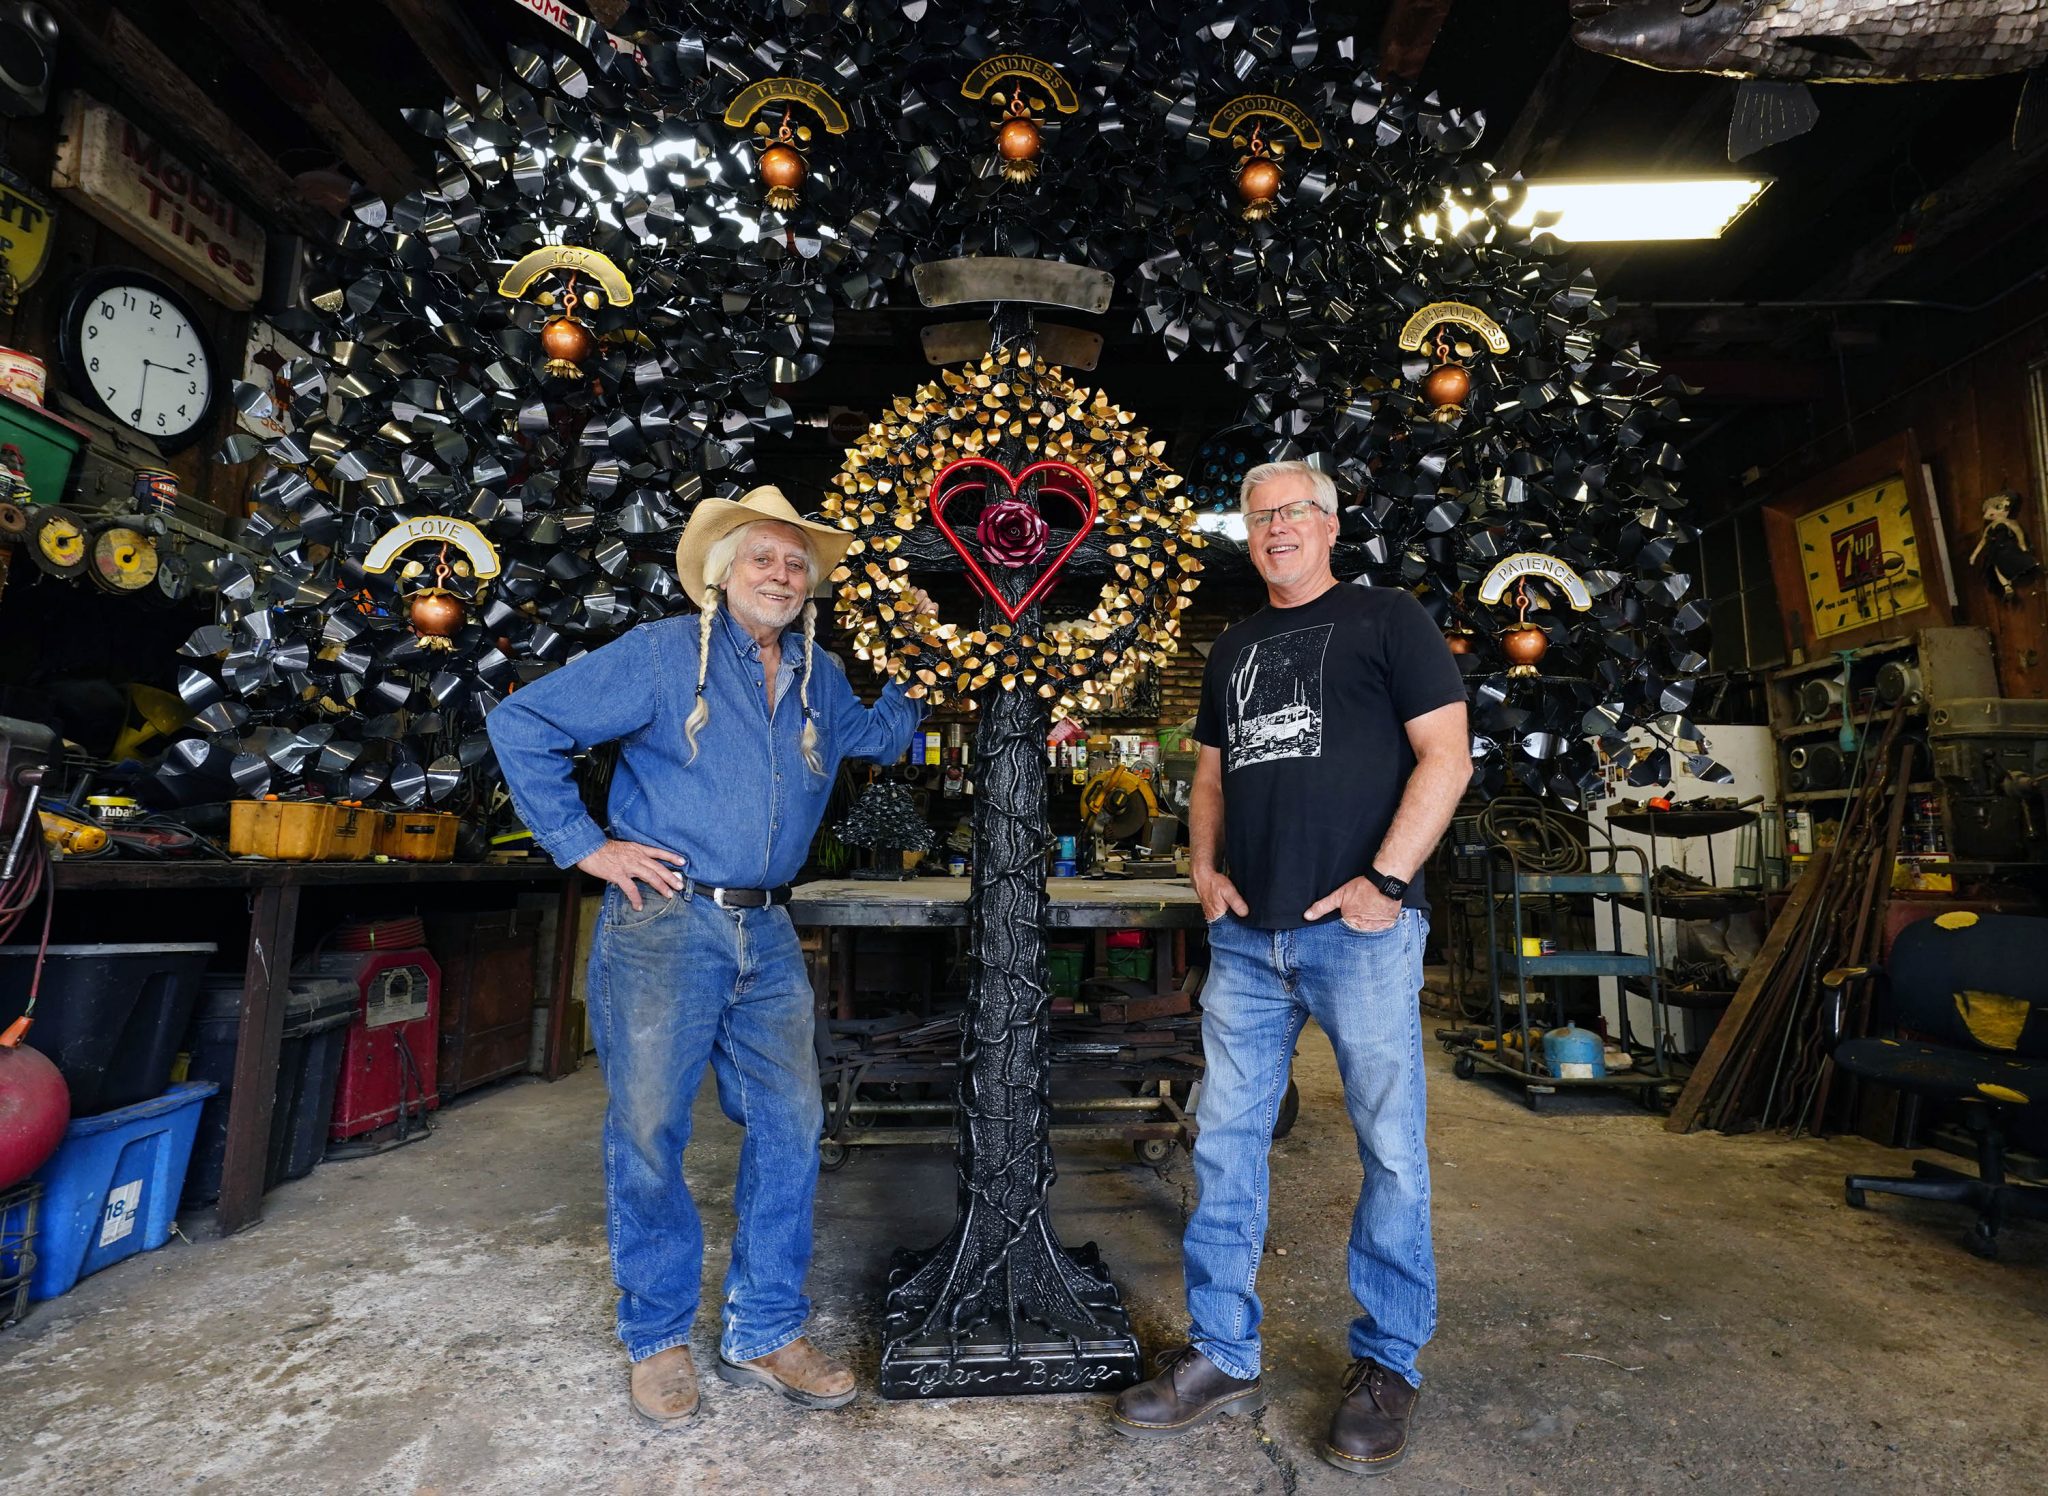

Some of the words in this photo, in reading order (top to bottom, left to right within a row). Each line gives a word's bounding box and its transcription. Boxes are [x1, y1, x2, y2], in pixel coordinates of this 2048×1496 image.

[980, 58, 1063, 88] KINDNESS
[756, 81, 819, 101] PEACE
[1223, 98, 1309, 130] GOODNESS
[121, 121, 239, 238] Mobil
[138, 175, 255, 286] Tires
[551, 251, 589, 265] JOY
[101, 301, 115, 320] 10
[122, 292, 136, 312] 11
[150, 301, 163, 319] 12
[88, 325, 98, 339] 9
[176, 325, 181, 338] 1
[1406, 306, 1505, 346] FAITHFULNESS
[89, 357, 100, 372] 8
[187, 353, 196, 367] 2
[107, 386, 116, 401] 7
[188, 381, 197, 395] 3
[131, 408, 142, 422] 6
[177, 404, 186, 417] 4
[156, 413, 166, 427] 5
[408, 521, 463, 539] LOVE
[1498, 558, 1575, 587] PATIENCE
[106, 1200, 125, 1221] 18
[897, 1364, 990, 1394] Tyler
